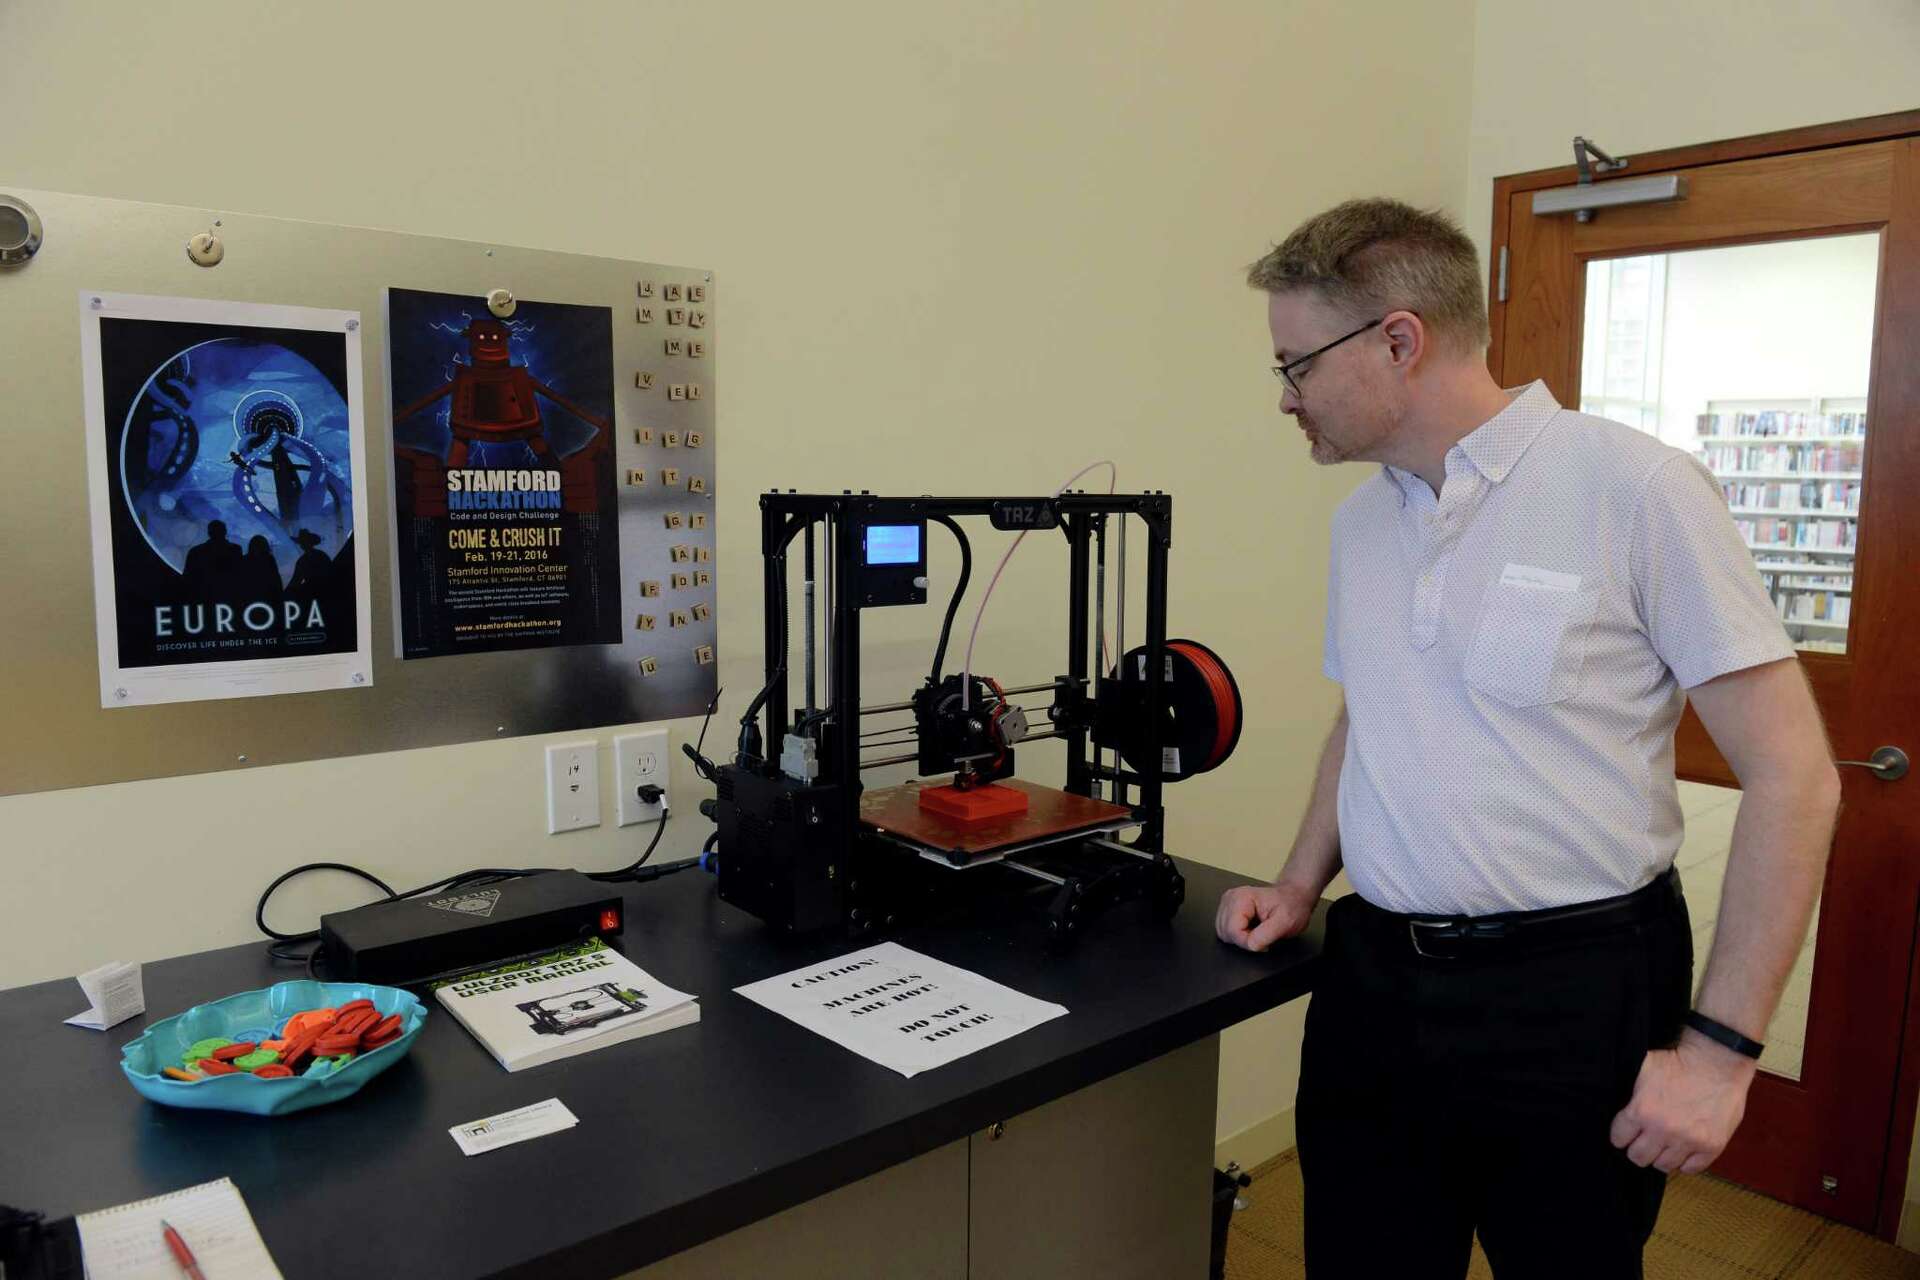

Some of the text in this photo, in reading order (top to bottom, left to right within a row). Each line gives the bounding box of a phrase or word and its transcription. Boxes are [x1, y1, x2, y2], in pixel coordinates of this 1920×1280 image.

[446, 469, 561, 492] STAMFORD
[447, 489, 562, 510] HACKATHON
[450, 510, 560, 521] Code and Design Challenge
[1002, 506, 1035, 523] TAZ
[448, 527, 563, 550] COME & CRUSH IT
[464, 552, 488, 562] Feb.
[524, 550, 548, 560] 2016
[447, 563, 569, 577] Stamford Innovation Center
[154, 599, 326, 636] EUROPA
[156, 642, 198, 652] DISCOVER
[200, 640, 217, 649] LIFE
[219, 639, 245, 648] UNDER
[248, 638, 263, 647] THE
[451, 968, 545, 992] LULZBOT
[546, 957, 588, 972] TAZ
[457, 959, 616, 999] USER MANUAL
[791, 958, 880, 989] CAUTION!
[822, 973, 922, 1010] MACHINES
[850, 983, 940, 1018] ARE HOT!
[898, 1003, 971, 1034] DO NOT
[919, 1012, 995, 1042] TOUCH!
